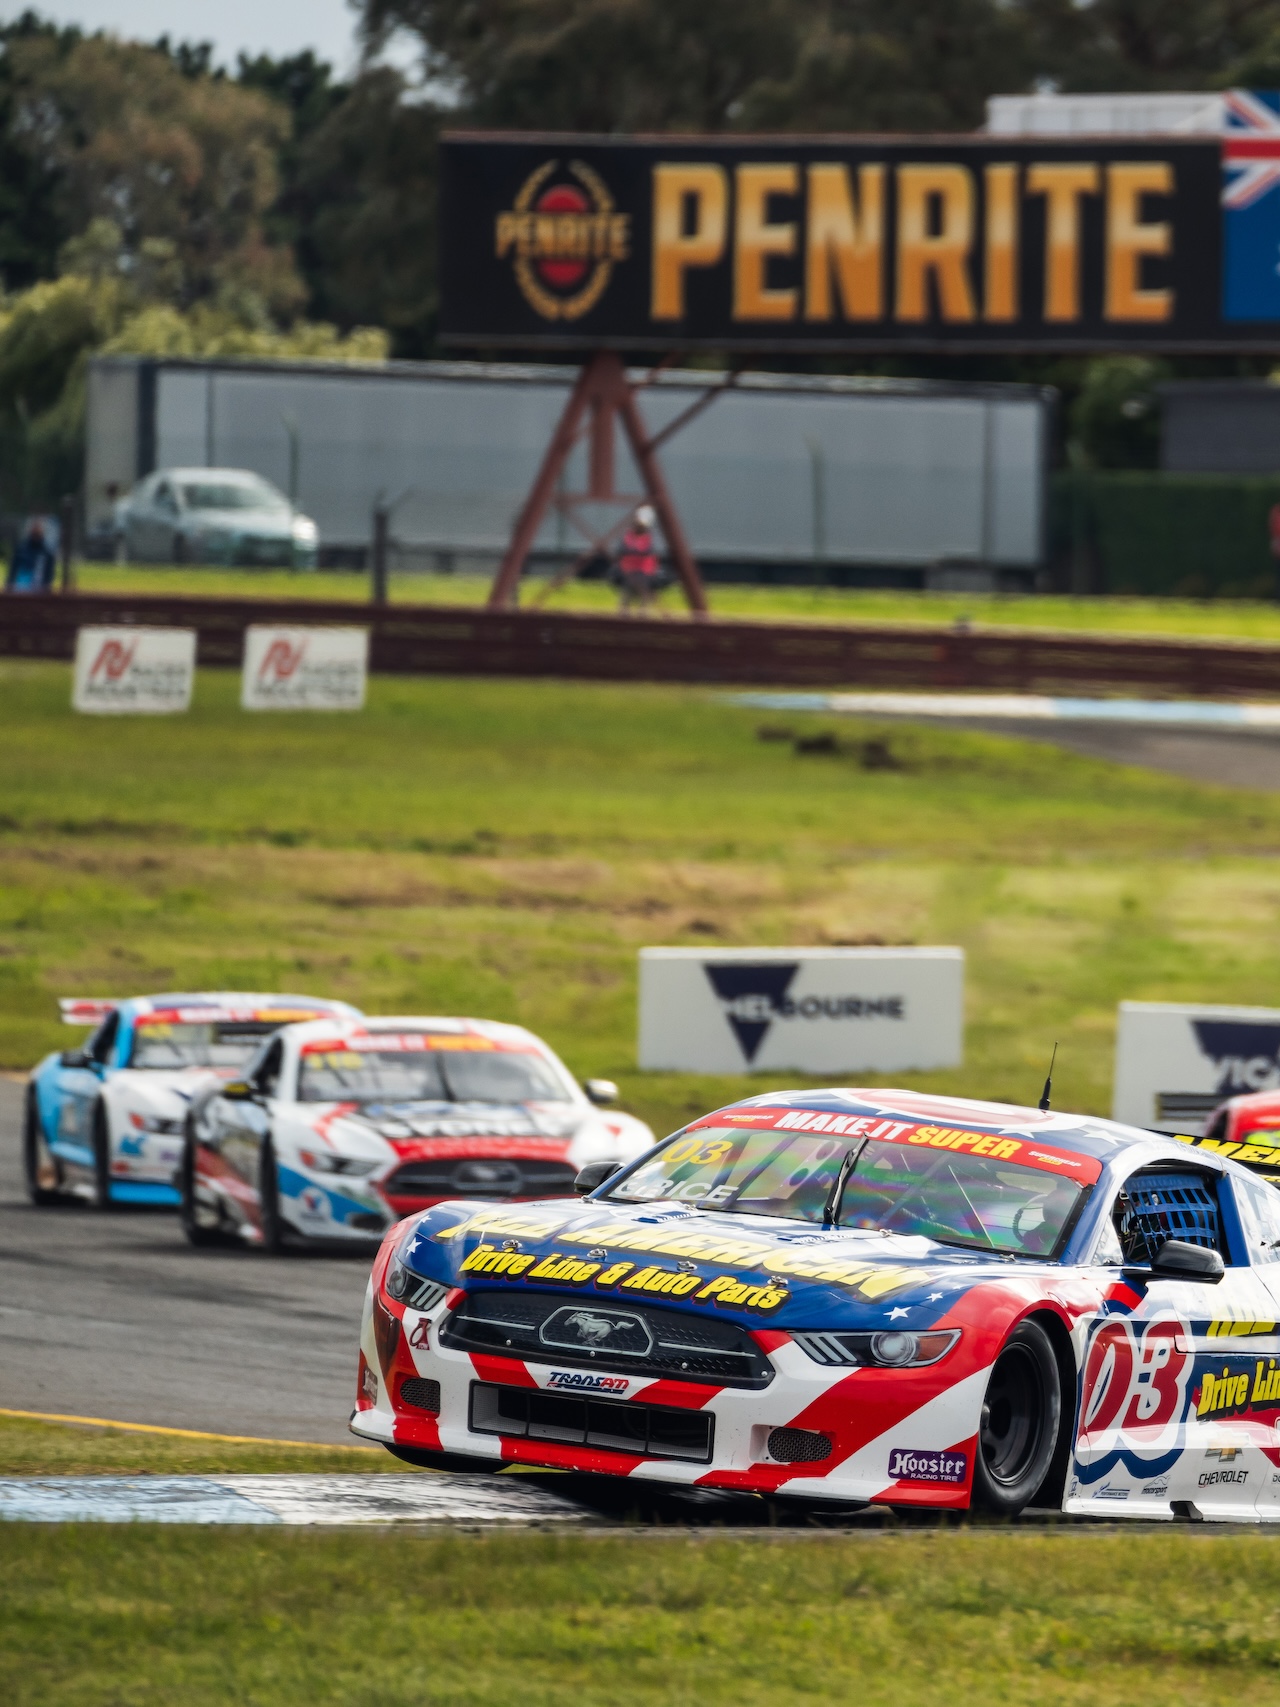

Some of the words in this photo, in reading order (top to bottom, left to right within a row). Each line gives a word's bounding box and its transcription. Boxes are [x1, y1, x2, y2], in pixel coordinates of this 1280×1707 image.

[496, 211, 632, 262] PENRITE
[651, 161, 1173, 322] PENRITE
[724, 994, 905, 1022] MELBOURNE
[661, 1139, 733, 1165] 03
[773, 1111, 863, 1136] MAKE
[863, 1121, 915, 1142] IT
[907, 1126, 1022, 1159] SUPER
[459, 1243, 537, 1276] Drive
[527, 1252, 602, 1283] Line
[596, 1261, 636, 1287] &
[621, 1265, 702, 1296] Auto
[695, 1274, 790, 1311] Parts
[1077, 1316, 1191, 1450] 03
[1197, 1366, 1250, 1417] Drive
[889, 1452, 965, 1475] Hoosier
[910, 1472, 938, 1480] RACING
[940, 1474, 958, 1482] TIRE
[1198, 1470, 1249, 1487] CHEVROLET
